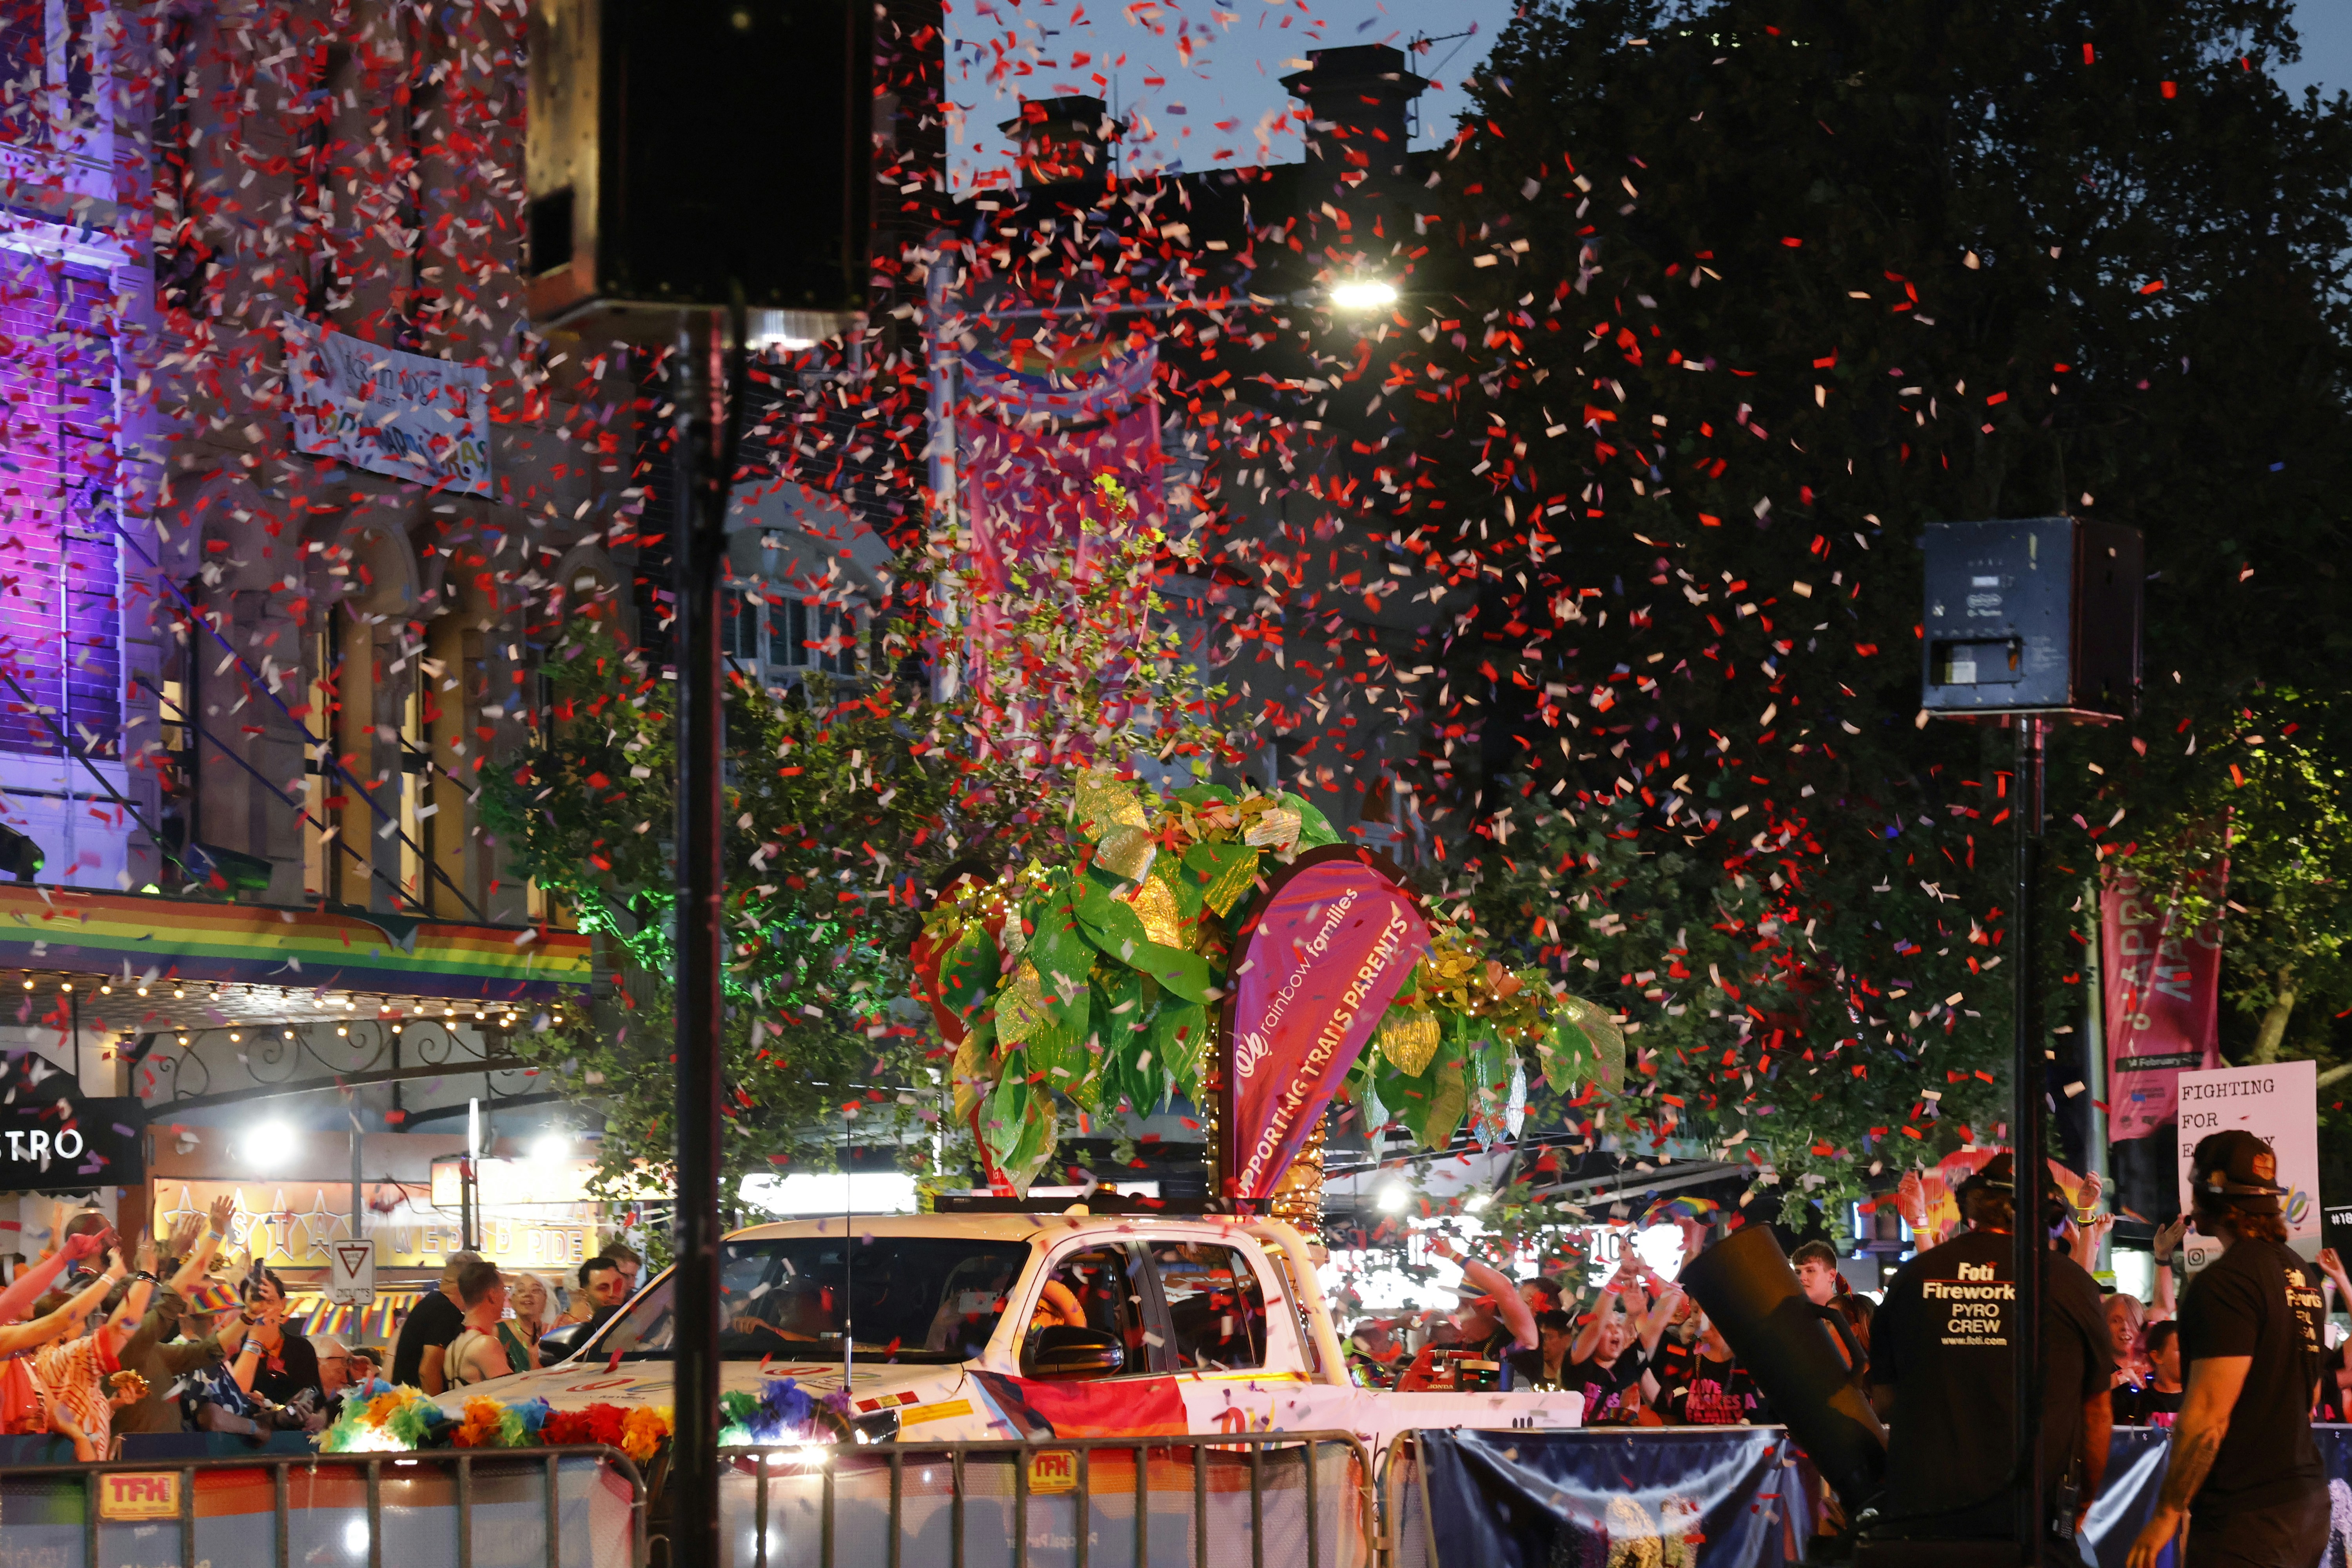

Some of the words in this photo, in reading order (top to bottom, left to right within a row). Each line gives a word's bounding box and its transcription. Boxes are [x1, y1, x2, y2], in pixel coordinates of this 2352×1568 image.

[1260, 956, 1311, 1035] rainbow
[1306, 888, 1357, 958] families
[1238, 1077, 1308, 1199] UPPORTING
[1300, 1007, 1352, 1077] TRANS
[1343, 915, 1408, 1010] PARENTS
[2182, 1079, 2274, 1100] FIGHTING
[2182, 1112, 2218, 1129] FOR
[0, 1128, 83, 1161] TRO
[230, 1211, 332, 1246] STA
[527, 1229, 583, 1265] PIDE
[1958, 1261, 1996, 1281] Foti
[1922, 1282, 2016, 1300] Firework
[1952, 1303, 2000, 1317] PYRO
[1947, 1319, 2001, 1333] CREW
[1941, 1336, 2007, 1346] www.foti.com
[110, 1477, 165, 1502] TFH
